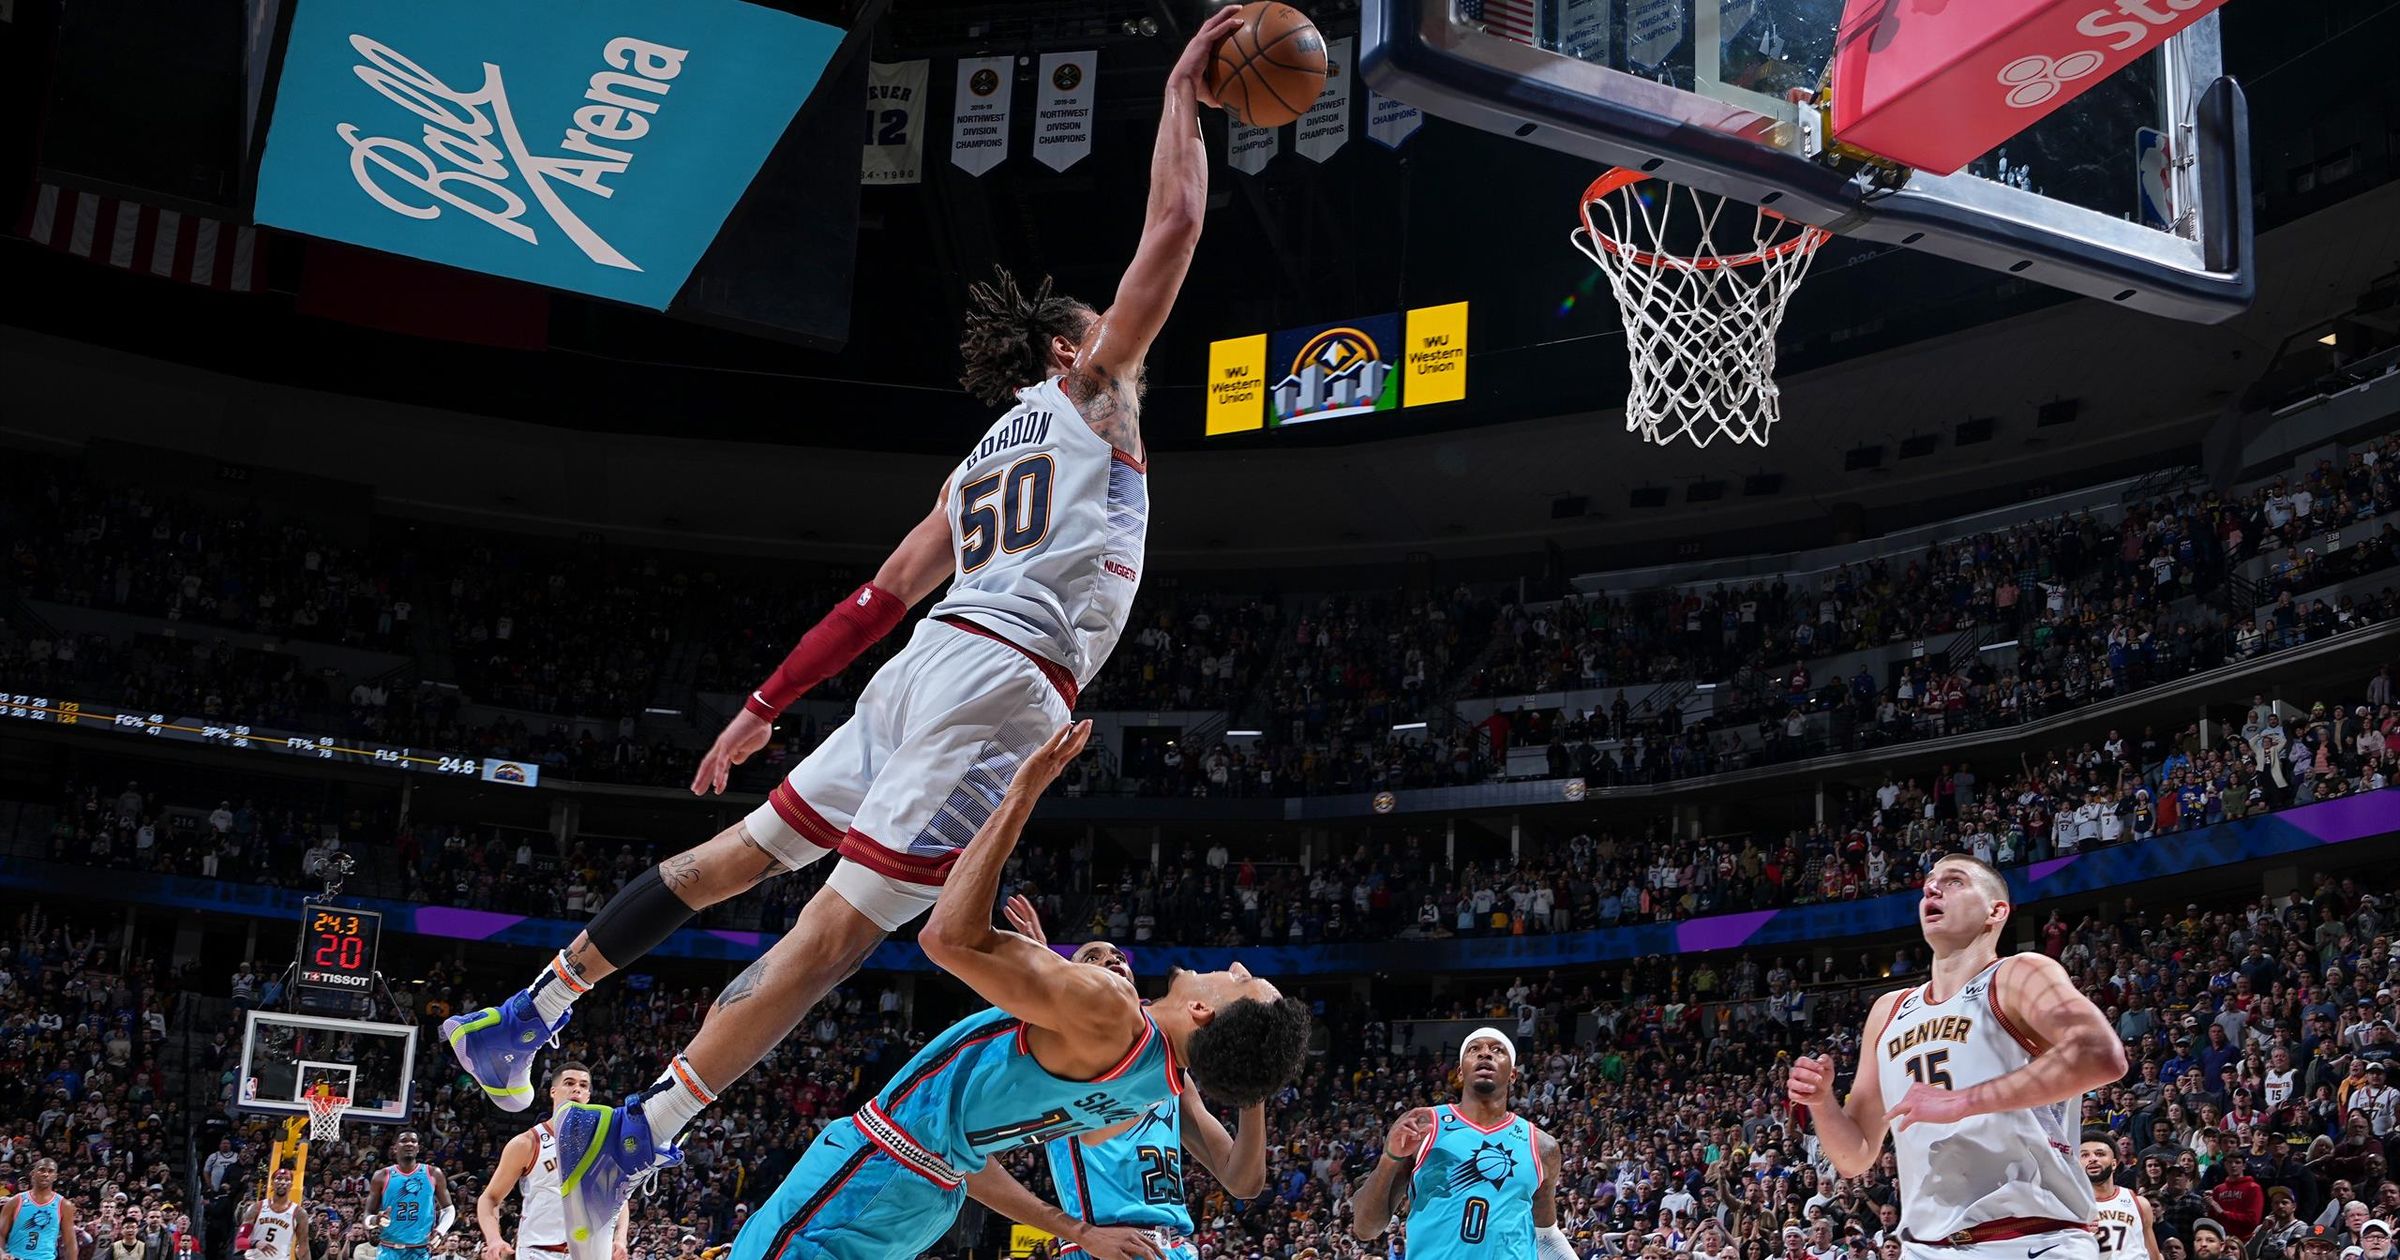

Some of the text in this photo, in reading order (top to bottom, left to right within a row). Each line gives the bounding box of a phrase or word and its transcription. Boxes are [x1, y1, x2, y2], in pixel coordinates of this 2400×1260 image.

[1637, 10, 1670, 31] DIVISION
[1566, 23, 1601, 44] MIDWEST
[869, 85, 912, 102] EVER
[1040, 108, 1089, 119] NORTHWEST
[1308, 98, 1347, 113] RTHWEST
[543, 36, 690, 200] Arena
[957, 113, 1006, 124] NORTHWEST
[1306, 113, 1339, 127] DIVISION
[1372, 108, 1417, 125] CHAMPIONS
[864, 109, 909, 146] 12
[962, 127, 997, 136] DIVISION
[1046, 121, 1081, 132] DIVISION
[1300, 124, 1344, 141] CHAMPIONS
[956, 138, 1003, 149] CHAMPIONS
[1039, 133, 1086, 145] CHAMPIONS
[1231, 136, 1273, 155] CHAMPIONS
[1409, 348, 1463, 364] Western
[1417, 361, 1455, 375] Union
[1211, 377, 1262, 393] Western
[1219, 391, 1253, 405] Union
[967, 411, 1053, 472] GORDON
[960, 452, 1055, 575] 50
[1104, 559, 1137, 582] NUGGETS
[115, 714, 145, 728] FG%
[202, 725, 231, 740] 3P%
[287, 738, 314, 751] FT%
[375, 749, 400, 762] FLS
[400, 759, 409, 769] 4
[313, 912, 359, 936] 24.3
[315, 933, 364, 970] 20
[321, 972, 369, 987] TISSOT
[1888, 1016, 1973, 1063] DENVER
[1905, 1048, 1953, 1092] 15
[2271, 1090, 2282, 1101] 15
[1136, 1145, 1184, 1206] 25
[2218, 1190, 2242, 1201] MIAMI
[396, 1201, 419, 1221] 22
[2097, 1210, 2135, 1227] NVER
[259, 1216, 290, 1230] DENVER
[1460, 1196, 1490, 1244] 0
[26, 1231, 40, 1251] 3
[265, 1228, 278, 1243] 5
[2096, 1225, 2128, 1254] 27
